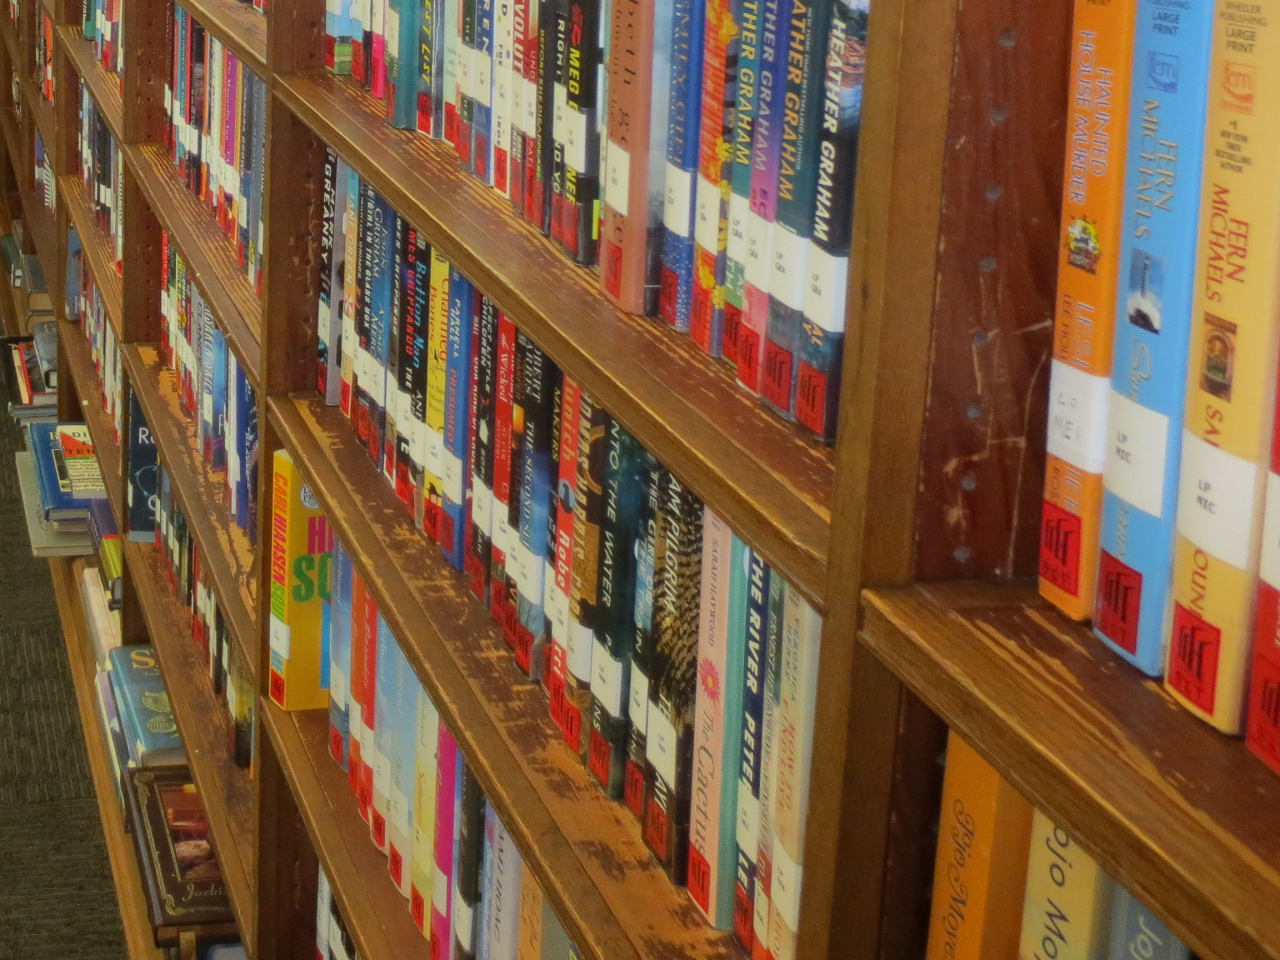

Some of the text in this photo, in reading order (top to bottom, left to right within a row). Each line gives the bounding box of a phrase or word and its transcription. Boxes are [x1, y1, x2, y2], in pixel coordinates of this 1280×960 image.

[421, 43, 431, 87] LIST
[568, 46, 581, 95] MEG
[1224, 27, 1258, 54] LARGE PRINT
[735, 66, 755, 166] GRAHAM
[754, 69, 775, 172] GRAHAM
[777, 90, 800, 202] GRAHAM
[812, 18, 847, 243] HEATHER GRAHAM
[1069, 29, 1098, 206] HOUSE MURDER
[1090, 67, 1115, 177] HAUNTED
[321, 162, 333, 265] GREANEY
[1133, 99, 1161, 239] MICHAELS
[1153, 139, 1179, 213] FERN
[328, 187, 337, 250] MARK
[345, 192, 357, 285] JANE GREEN
[372, 207, 386, 278] GRISHAM
[380, 226, 389, 269] JOHN
[1205, 182, 1231, 304] MICHAELS
[1225, 216, 1251, 284] FERN
[404, 269, 416, 358] GRIPPANDO
[412, 260, 428, 371] Button Man
[428, 284, 438, 342] Bones
[452, 297, 462, 360] PARNELL
[479, 295, 489, 368] CHILDREN
[404, 366, 414, 389] THE
[447, 368, 457, 443] PRESUMED
[483, 346, 493, 395] LITTLE
[499, 352, 509, 404] Wicked
[525, 421, 535, 452] THE
[551, 386, 561, 462] MAKERS
[271, 471, 289, 586] CARL HIAASEN
[601, 477, 619, 610] THE WATER
[663, 472, 682, 613] AM PILGRIM
[706, 536, 720, 647] SARAH HAYWOOD
[745, 551, 764, 697] THE RIVER
[693, 707, 716, 856] The Cactus
